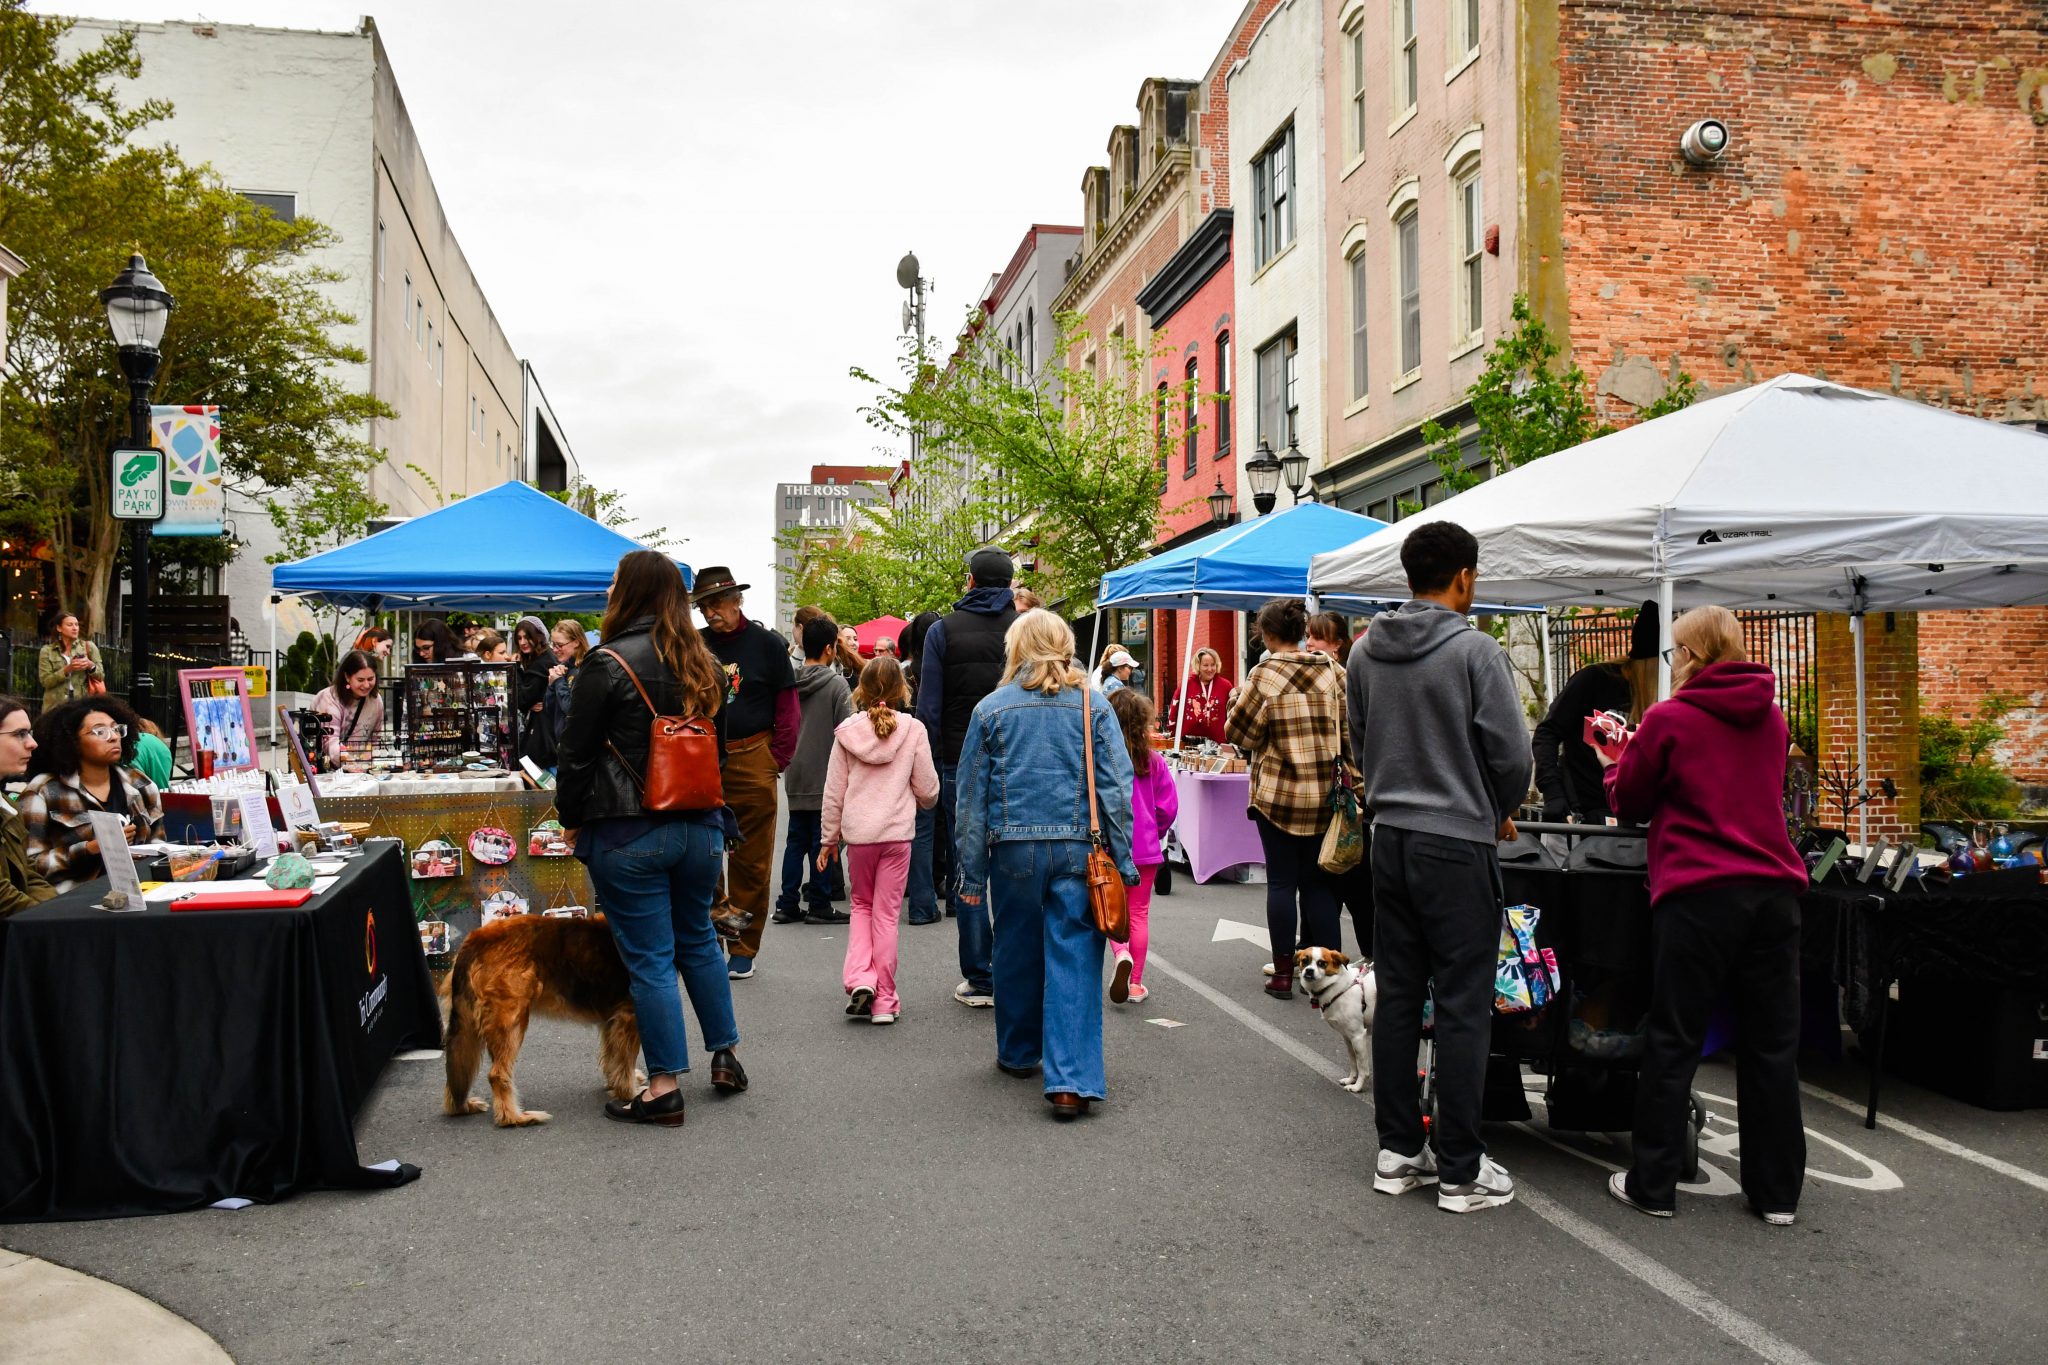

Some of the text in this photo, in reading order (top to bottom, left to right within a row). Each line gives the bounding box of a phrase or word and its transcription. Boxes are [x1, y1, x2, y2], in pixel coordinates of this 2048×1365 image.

[118, 489, 157, 500] PAY TO
[785, 485, 849, 496] THE ROSS
[123, 500, 152, 511] PARK
[165, 498, 218, 507] OWNTOWN
